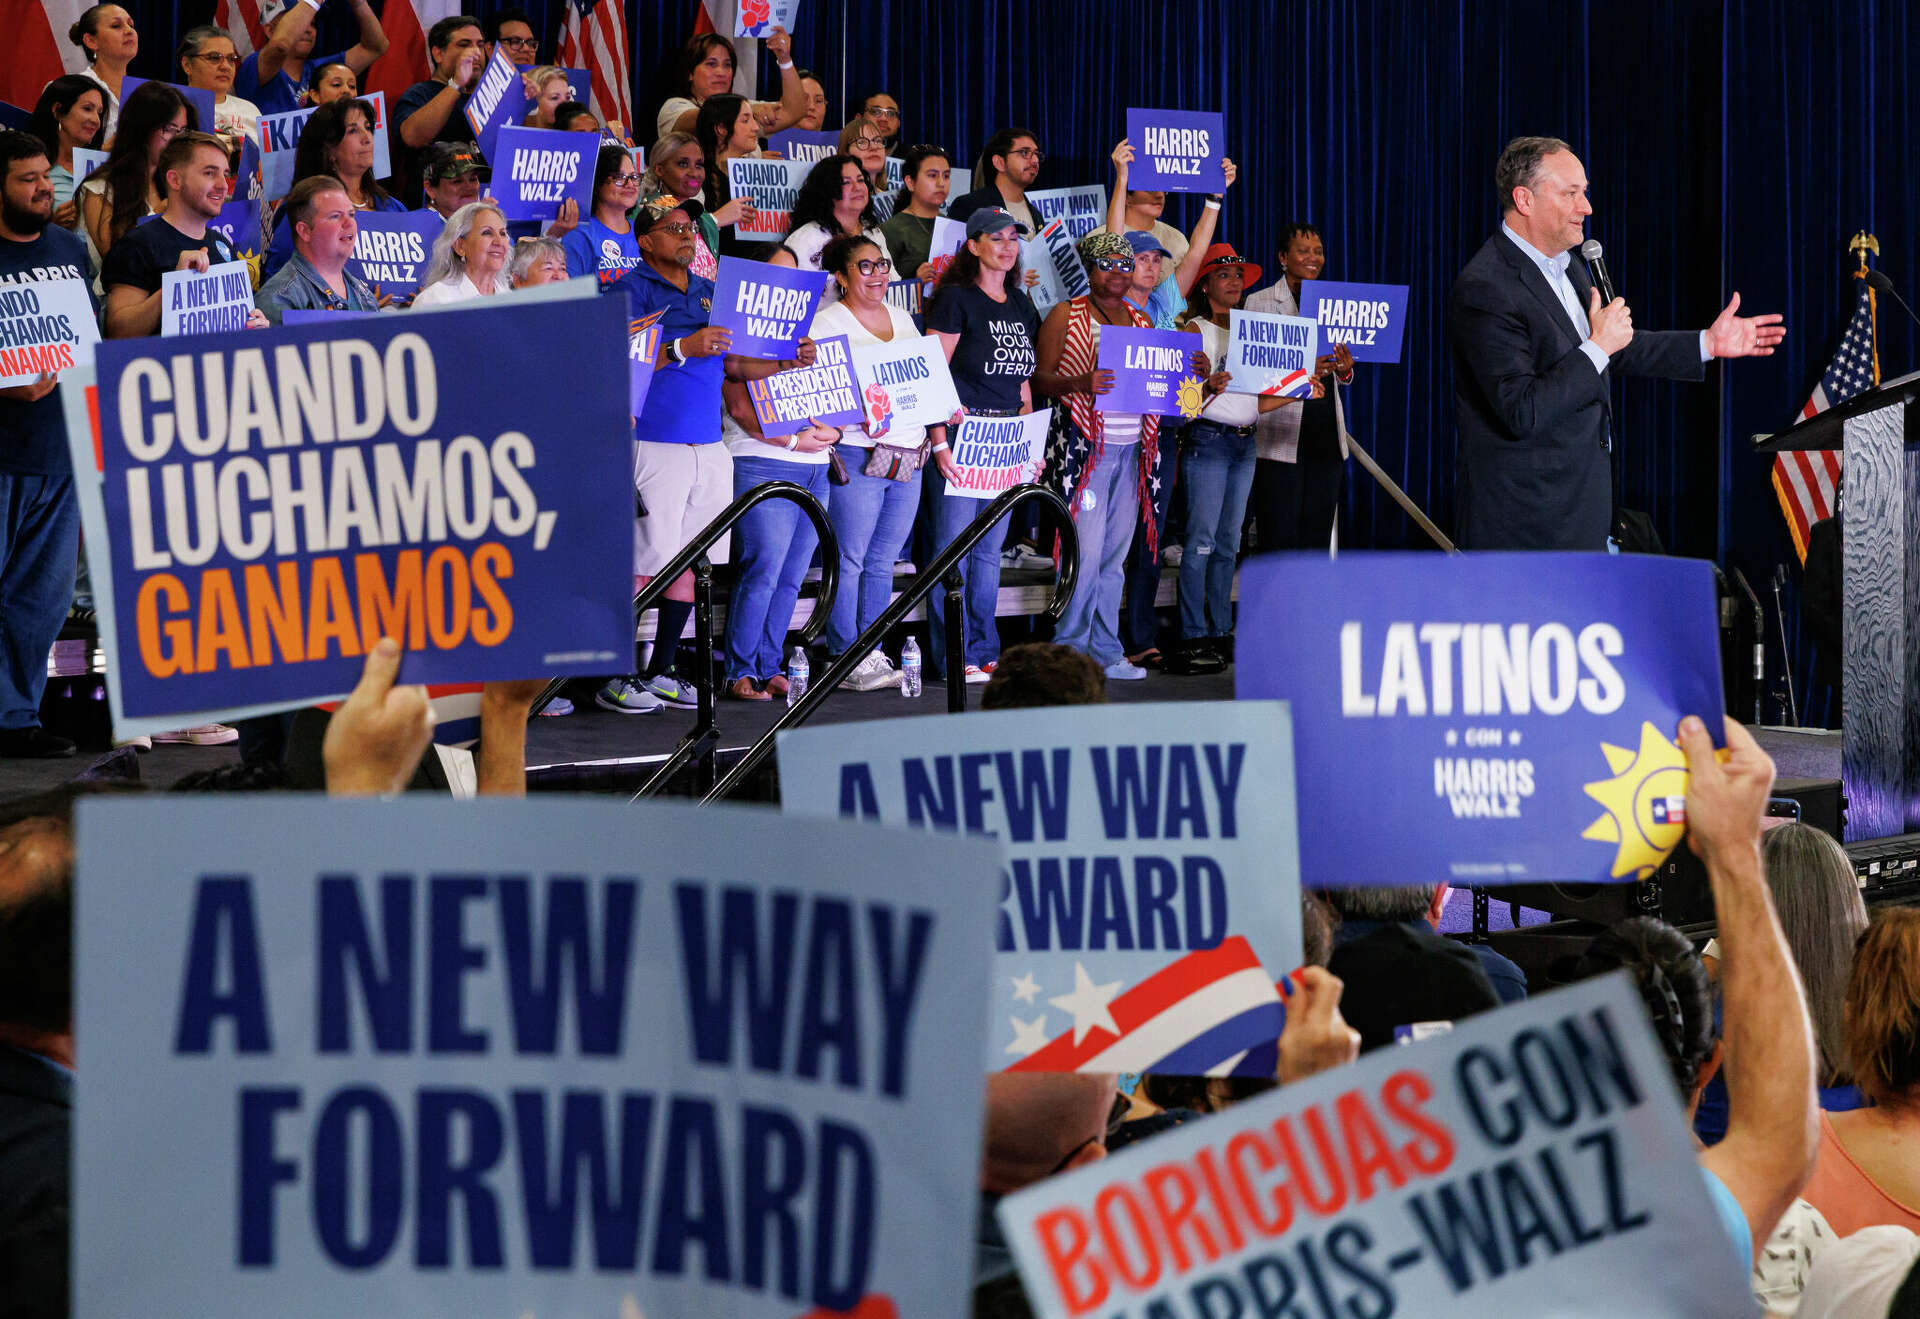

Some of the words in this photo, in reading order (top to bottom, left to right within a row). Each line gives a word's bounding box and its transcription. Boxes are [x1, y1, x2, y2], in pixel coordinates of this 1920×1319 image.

[788, 141, 839, 163] LATINO
[1144, 127, 1210, 158] HARRIS
[512, 148, 580, 183] HARRIS
[732, 163, 788, 187] CUANDO
[1154, 157, 1201, 175] WALZ
[520, 182, 565, 202] WALZ
[735, 186, 800, 211] LUCHAMO
[1068, 193, 1099, 217] WAY
[738, 211, 790, 233] GANAM
[362, 262, 417, 282] WALZ
[172, 283, 183, 311] A
[187, 276, 219, 309] NEW
[221, 271, 249, 302] WAY
[735, 280, 811, 321] HARRIS
[179, 303, 249, 337] FORWARD
[746, 317, 797, 341] WALZ
[989, 320, 1025, 335] MIND
[1317, 298, 1390, 329] HARRIS
[0, 314, 79, 349] HAMOS,
[992, 334, 1032, 349] YOUR
[1238, 318, 1247, 341] A
[1250, 319, 1278, 346] NEW
[1281, 323, 1310, 348] WAY
[1327, 327, 1377, 346] WALZ
[994, 347, 1035, 363] OWN
[1125, 345, 1183, 373] LATINOS
[1242, 344, 1305, 372] FORWARD
[750, 379, 771, 401] LA
[767, 364, 853, 400] PRESIDENTA
[872, 355, 930, 387] LATINOS
[118, 332, 438, 462] CUANDO
[756, 400, 778, 425] LA
[773, 387, 858, 423] PRESIDENTA
[962, 420, 1024, 444] CUANDO
[956, 440, 1031, 468] LUCHAMOS,
[126, 431, 557, 571] LUCHAMOS,
[136, 542, 514, 680] GANAMOS
[1341, 621, 1626, 717] LATINOS
[1465, 728, 1502, 747] CON
[902, 747, 1071, 843] NEW
[1090, 743, 1246, 840] WAY
[1434, 757, 1535, 798] HARRIS
[1448, 794, 1521, 819] WALZ
[996, 855, 1228, 953] WARD
[173, 872, 273, 1057] A
[315, 872, 641, 1059] NEW
[671, 877, 936, 1102] WAY
[1034, 1069, 1456, 1318] BORICUAS
[1454, 1005, 1643, 1151] CON
[237, 1082, 879, 1314] FORWARD
[1105, 1125, 1653, 1319] RIS-WALZ
